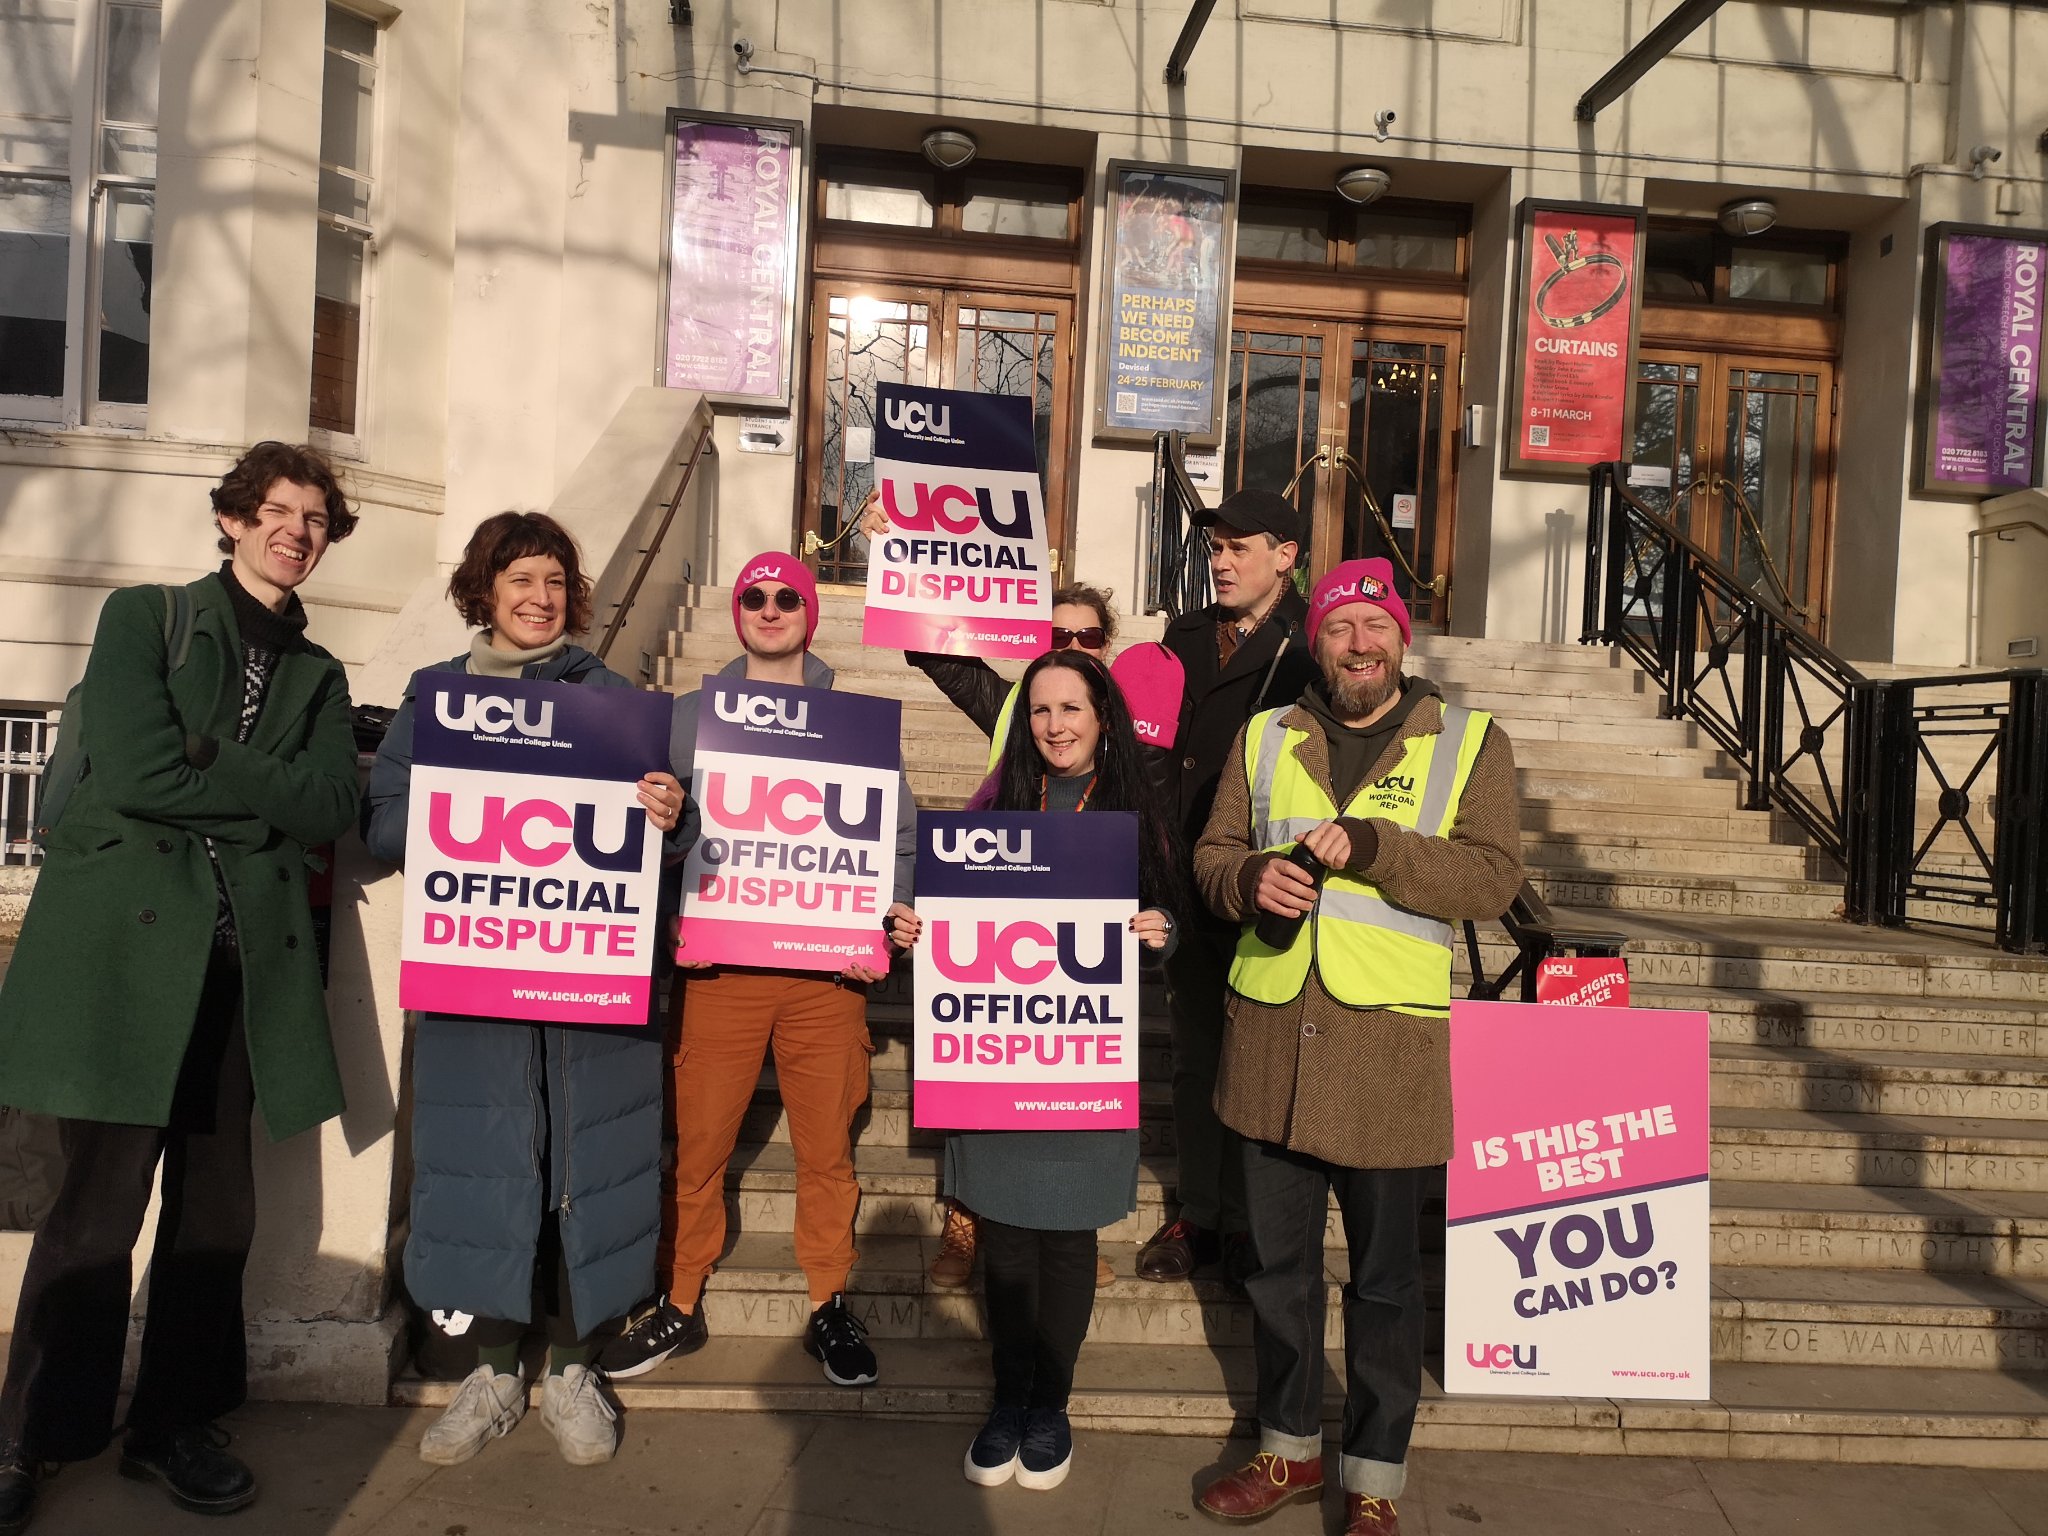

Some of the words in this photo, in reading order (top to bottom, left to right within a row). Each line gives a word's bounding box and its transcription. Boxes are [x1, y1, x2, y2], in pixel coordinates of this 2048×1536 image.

[752, 134, 781, 234] ROYAL
[1121, 293, 1196, 313] PERHAPS
[2011, 246, 2039, 337] ROYAL
[746, 243, 777, 384] CENTRAL
[1121, 310, 1147, 326] WE
[1151, 312, 1195, 329] NEED
[1119, 326, 1190, 345] BECOME
[1118, 343, 1202, 363] INDECENT
[1534, 337, 1618, 358] CURTAINS
[1118, 362, 1150, 372] Devised
[1117, 374, 1148, 387] 24-25
[1150, 376, 1205, 390] FEBRUARY
[1530, 407, 1550, 418] 8-11
[1552, 409, 1592, 421] MARCH
[2003, 344, 2033, 475] CENTRAL
[903, 432, 924, 442] University
[933, 436, 951, 444] College
[951, 437, 965, 445] Union
[1941, 447, 1955, 456] 020
[1956, 448, 1972, 457] 7722
[883, 538, 1037, 571] OFFICIAL
[881, 570, 1038, 605] DISPUTE
[473, 733, 509, 744] University
[524, 738, 550, 747] College
[551, 740, 572, 748] Union
[744, 725, 772, 734] University
[784, 729, 805, 738] College
[1368, 793, 1415, 807] WORKLOAD
[1379, 801, 1399, 811] REP
[701, 838, 879, 877] OFFICIAL
[964, 864, 995, 872] University
[1007, 865, 1031, 873] College
[1647, 852, 1690, 867] ANN
[424, 870, 640, 915] OFFICIAL
[698, 874, 877, 914] DISPUTE
[1557, 884, 1618, 901] HELEN
[1637, 889, 1727, 908] LEDERER
[424, 912, 636, 957] DISPUTE
[773, 940, 873, 956] www.ucu.org.uk
[1580, 973, 1625, 999] FIGHTS
[1791, 965, 1919, 988] MEREDITH
[1940, 972, 2000, 992] KATE
[512, 988, 631, 1005] www.ucu.org.uk
[931, 992, 1123, 1025] OFFICIAL
[1814, 1021, 1920, 1043] HAROLD
[1940, 1026, 2030, 1048] PINTER
[933, 1033, 1122, 1065] DISPUTE
[1732, 1078, 1874, 1104] ROBINSON
[1900, 1086, 1972, 1109] TONY
[1014, 1098, 1122, 1112] www.ucu.org.uk
[1472, 1136, 1509, 1170] IS
[1512, 1119, 1599, 1161] THIS
[1602, 1104, 1677, 1144] THE
[1536, 1148, 1624, 1192] BEST
[1844, 1154, 1940, 1179] SIMON
[1494, 1201, 1654, 1279] YOU
[1857, 1236, 2006, 1262] TIMOTHY
[1513, 1277, 1594, 1319] CAN
[1600, 1260, 1678, 1303] DO?
[1764, 1324, 1819, 1352] ZOË
[1843, 1329, 2048, 1359] WANAMAKER
[1612, 1370, 1690, 1380] www.ucu.org.uk
